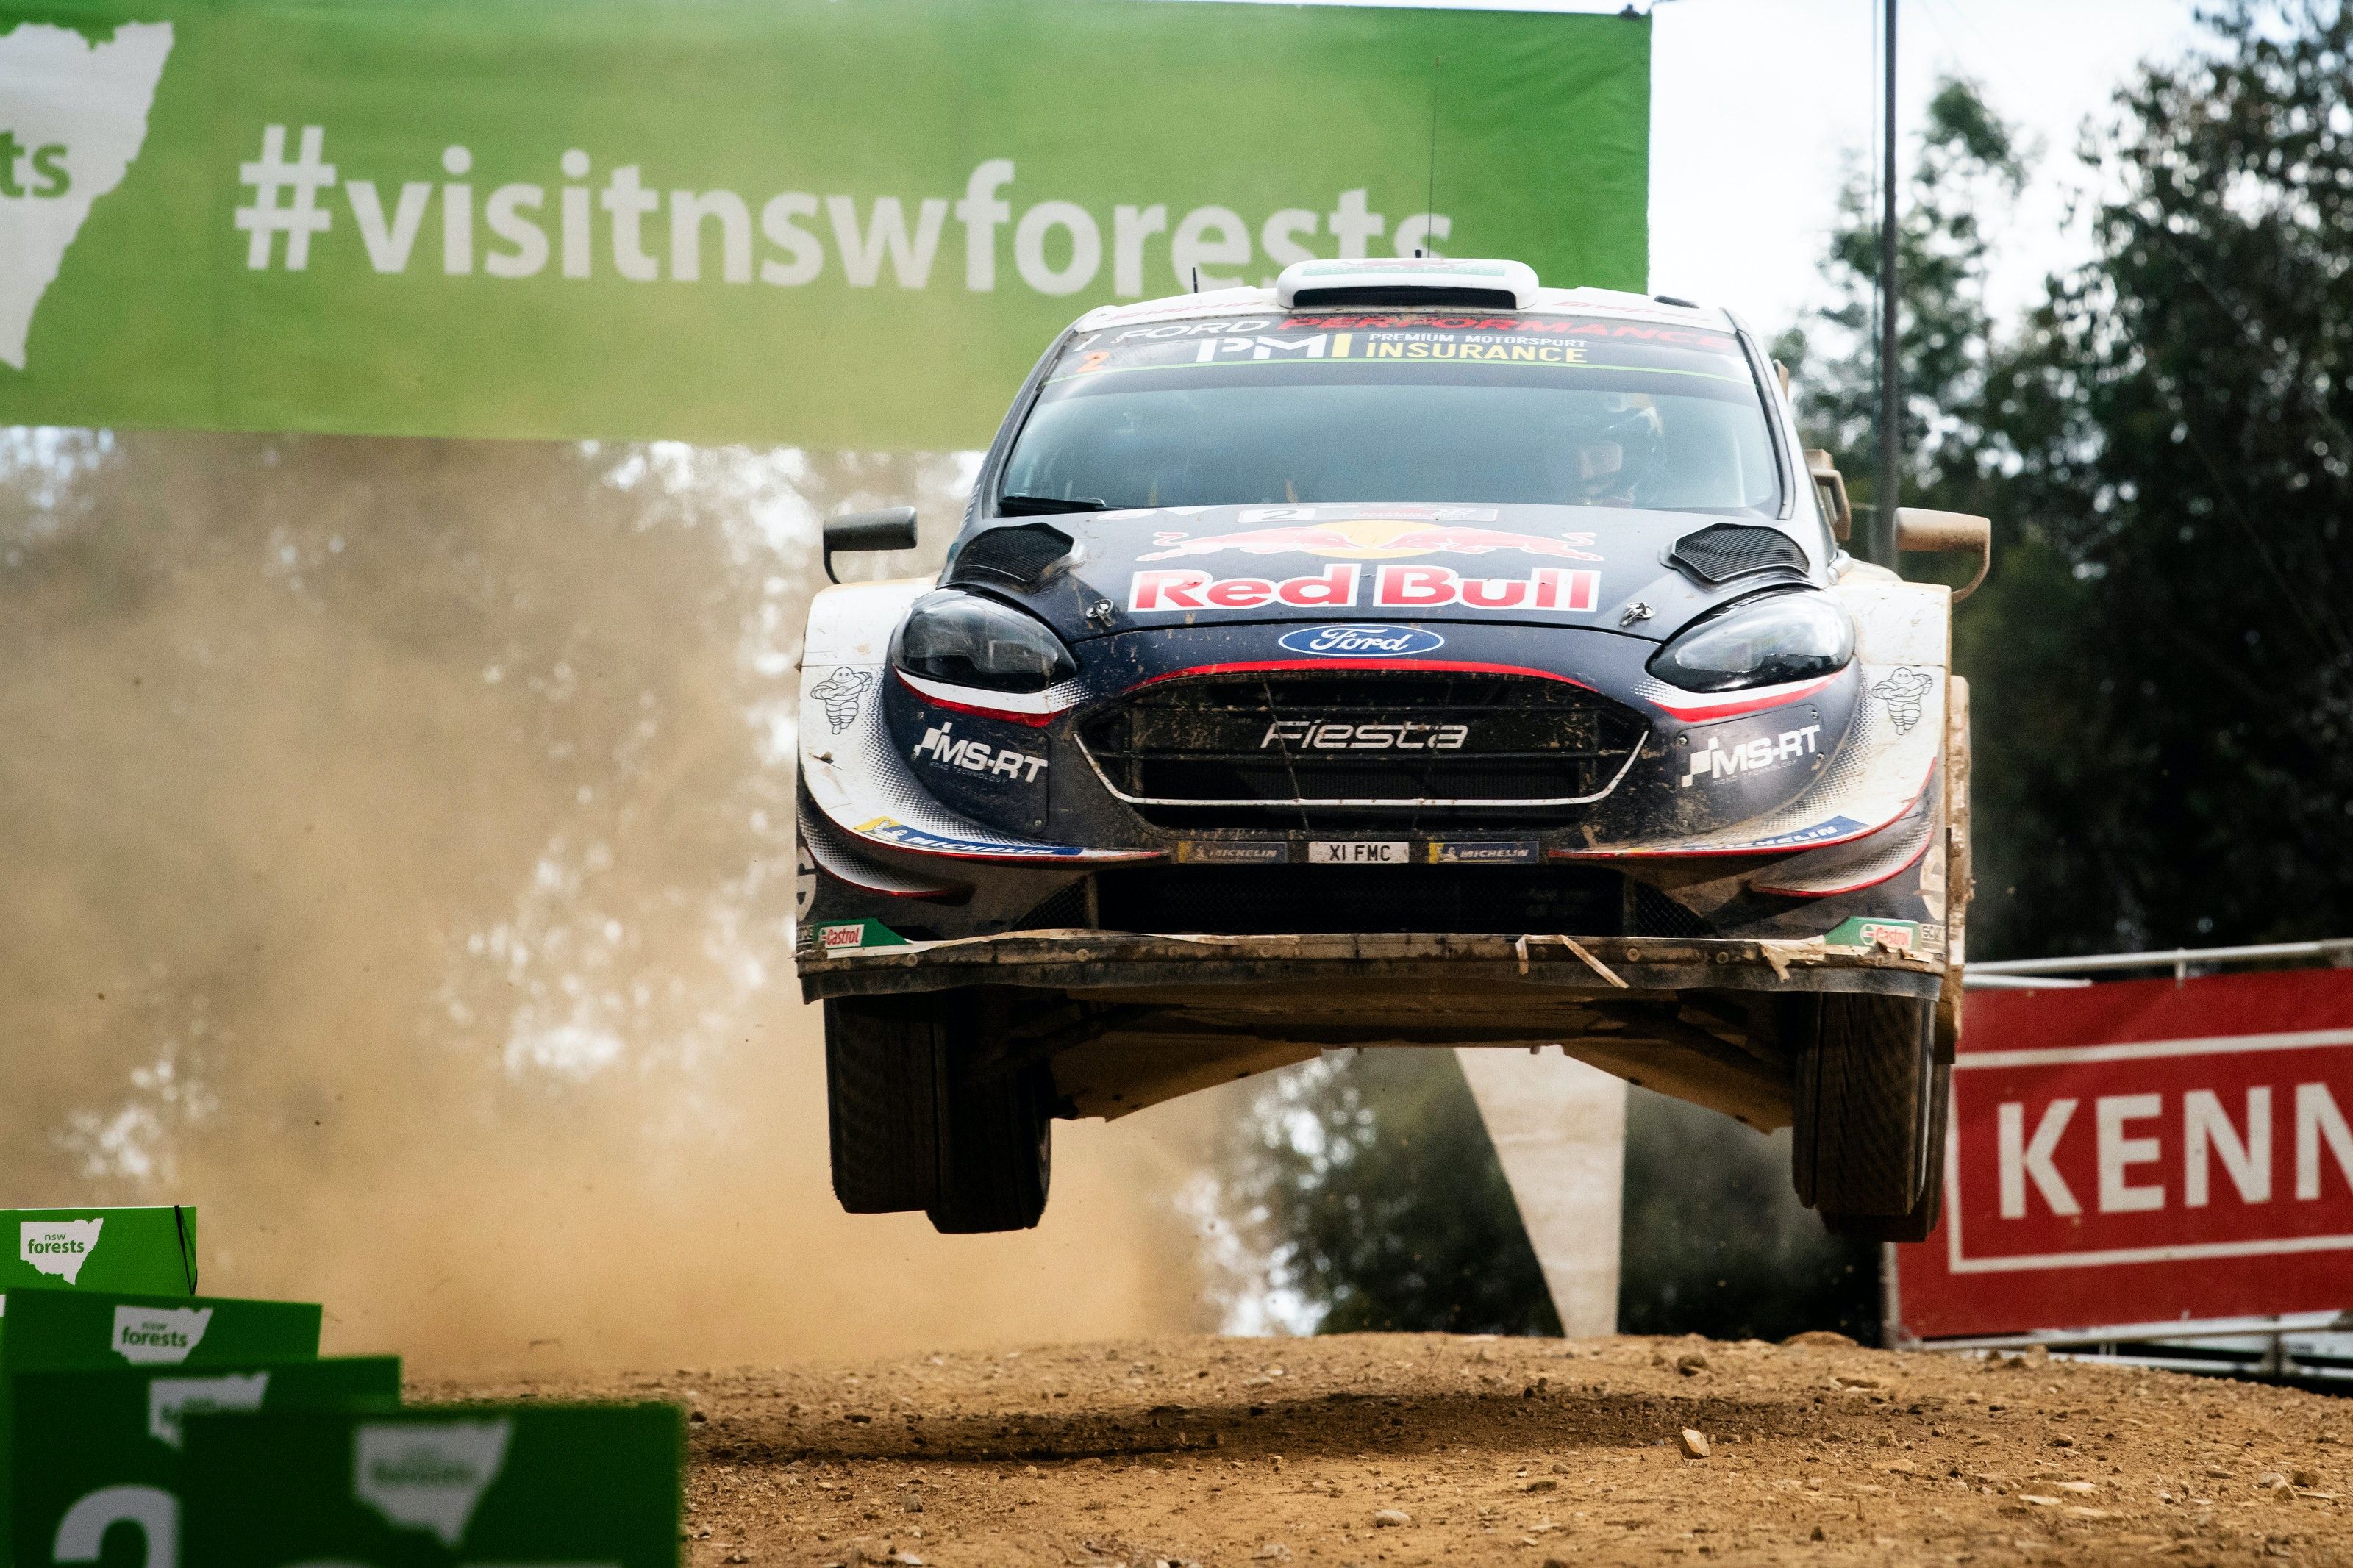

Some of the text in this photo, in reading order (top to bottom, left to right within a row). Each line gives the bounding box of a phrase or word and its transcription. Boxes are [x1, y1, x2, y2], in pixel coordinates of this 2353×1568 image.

[1111, 315, 1735, 350] FORD PERFORMANCE
[1368, 333, 1588, 348] PREMIUM MOTORSPORT
[1196, 332, 1352, 362] PMI
[1365, 343, 1588, 363] INSURANCE
[1076, 351, 1110, 373] 2
[1260, 509, 1299, 520] 2
[1132, 565, 1596, 610] Red Bull
[1311, 626, 1413, 653] Ford
[1259, 719, 1469, 749] Fiesta
[932, 735, 1049, 784] MS-RT
[1712, 725, 1821, 779] MS-RT
[904, 837, 1056, 854] MICHELIN
[1694, 826, 1839, 851] CHELIN
[1210, 848, 1278, 858] MICHELIN
[1354, 845, 1392, 862] FMC
[1460, 848, 1529, 858] MICHELIN
[826, 927, 860, 945] Castrol
[1998, 1082, 2353, 1220] KENN
[27, 1238, 85, 1254] forests
[44, 1233, 66, 1242] nsw
[122, 1326, 188, 1348] forests
